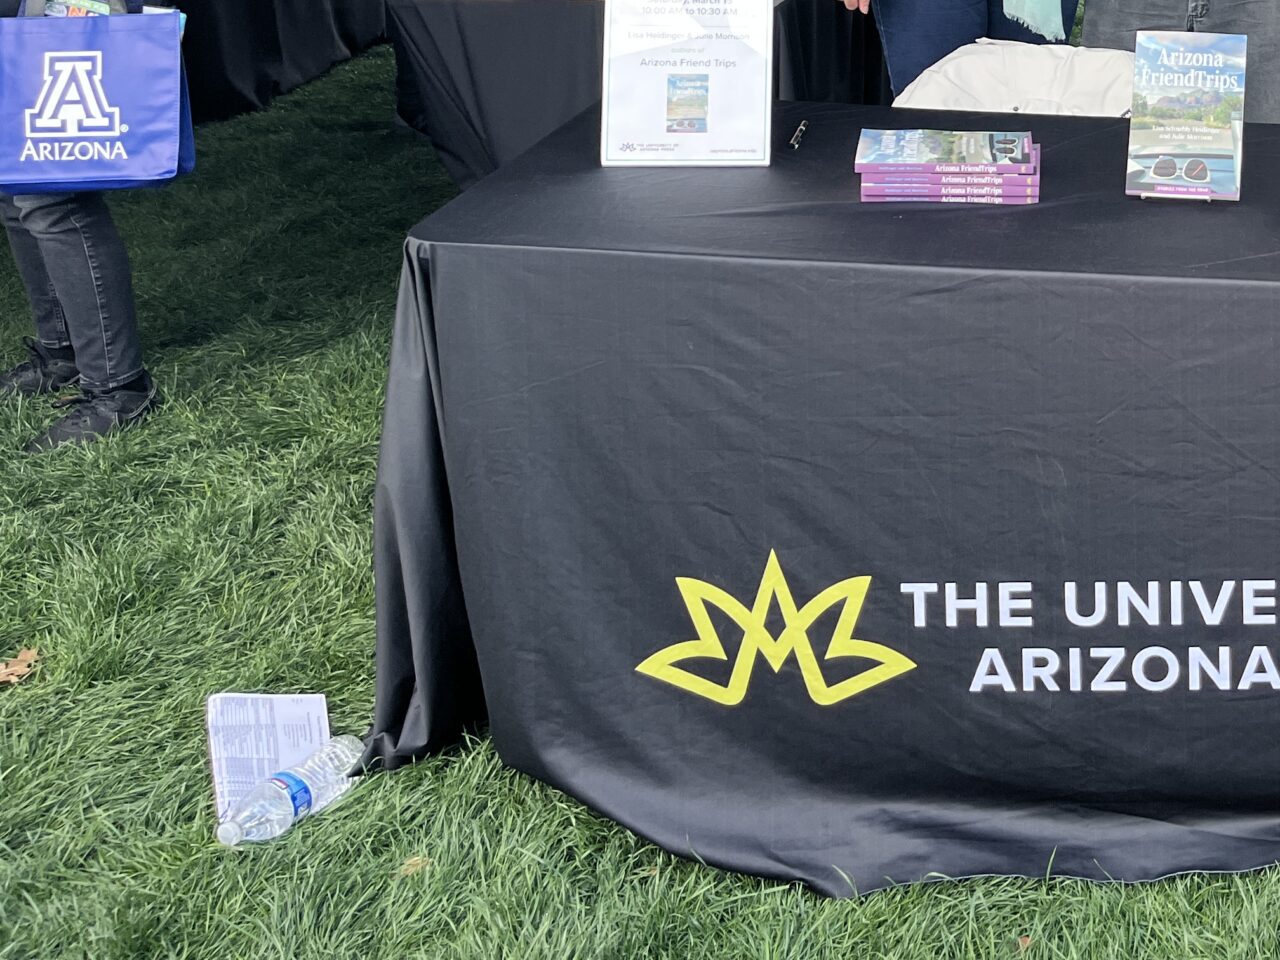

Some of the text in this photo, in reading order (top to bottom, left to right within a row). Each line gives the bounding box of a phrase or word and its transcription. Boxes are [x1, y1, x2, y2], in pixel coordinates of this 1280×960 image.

[685, 8, 694, 16] to
[697, 7, 721, 16] 10:30
[723, 7, 738, 16] AM
[1157, 47, 1224, 68] Arizona
[640, 58, 737, 69] Arizona Friend Trips
[1140, 67, 1238, 93] FriendTrips
[20, 140, 128, 161] ARIZONA
[935, 164, 997, 173] Arizona FriendTrips
[967, 176, 1003, 185] FriendTrips
[967, 187, 1002, 196] FriendTrips
[967, 196, 1002, 204] FriendTrips
[900, 581, 1033, 628] THE
